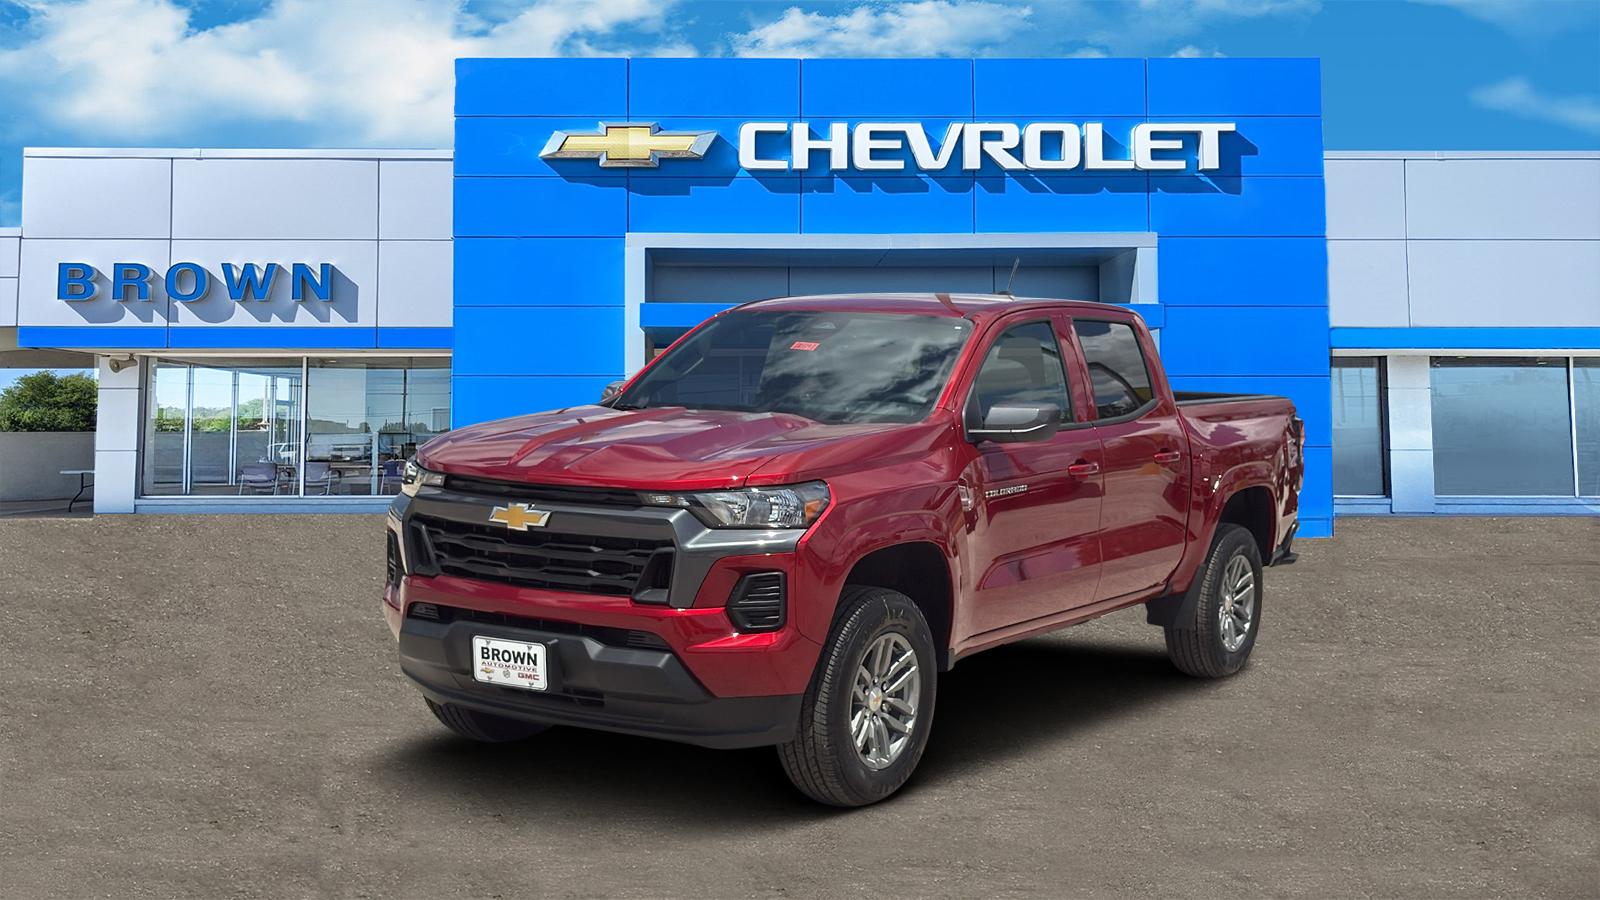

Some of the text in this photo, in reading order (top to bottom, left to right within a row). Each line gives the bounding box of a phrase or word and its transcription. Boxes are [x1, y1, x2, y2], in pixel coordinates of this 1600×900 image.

[738, 122, 1236, 170] CHEVROLET
[57, 262, 333, 301] BROWN
[481, 646, 538, 666] BROWN
[481, 661, 537, 672] AUTOMOTIVE
[517, 672, 540, 681] GMC
